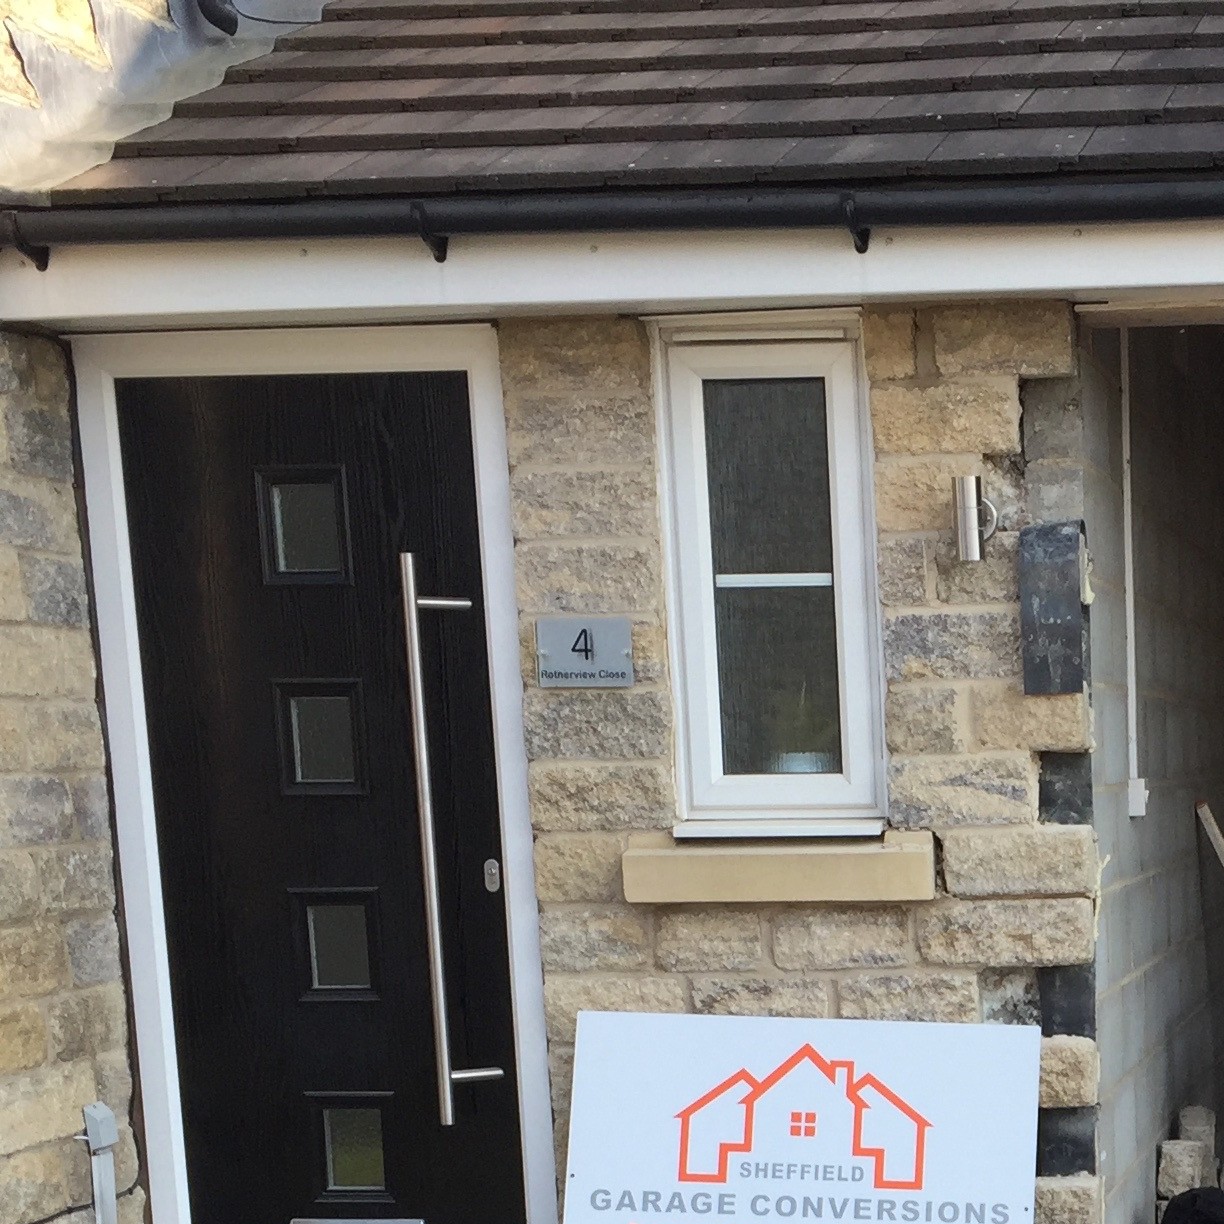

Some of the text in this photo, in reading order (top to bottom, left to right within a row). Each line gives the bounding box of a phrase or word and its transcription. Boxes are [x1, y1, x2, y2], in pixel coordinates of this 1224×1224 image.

[571, 629, 592, 660] 4
[598, 670, 626, 679] Close
[739, 1161, 865, 1183] SHEFFIELD
[590, 1189, 737, 1215] GARAGE
